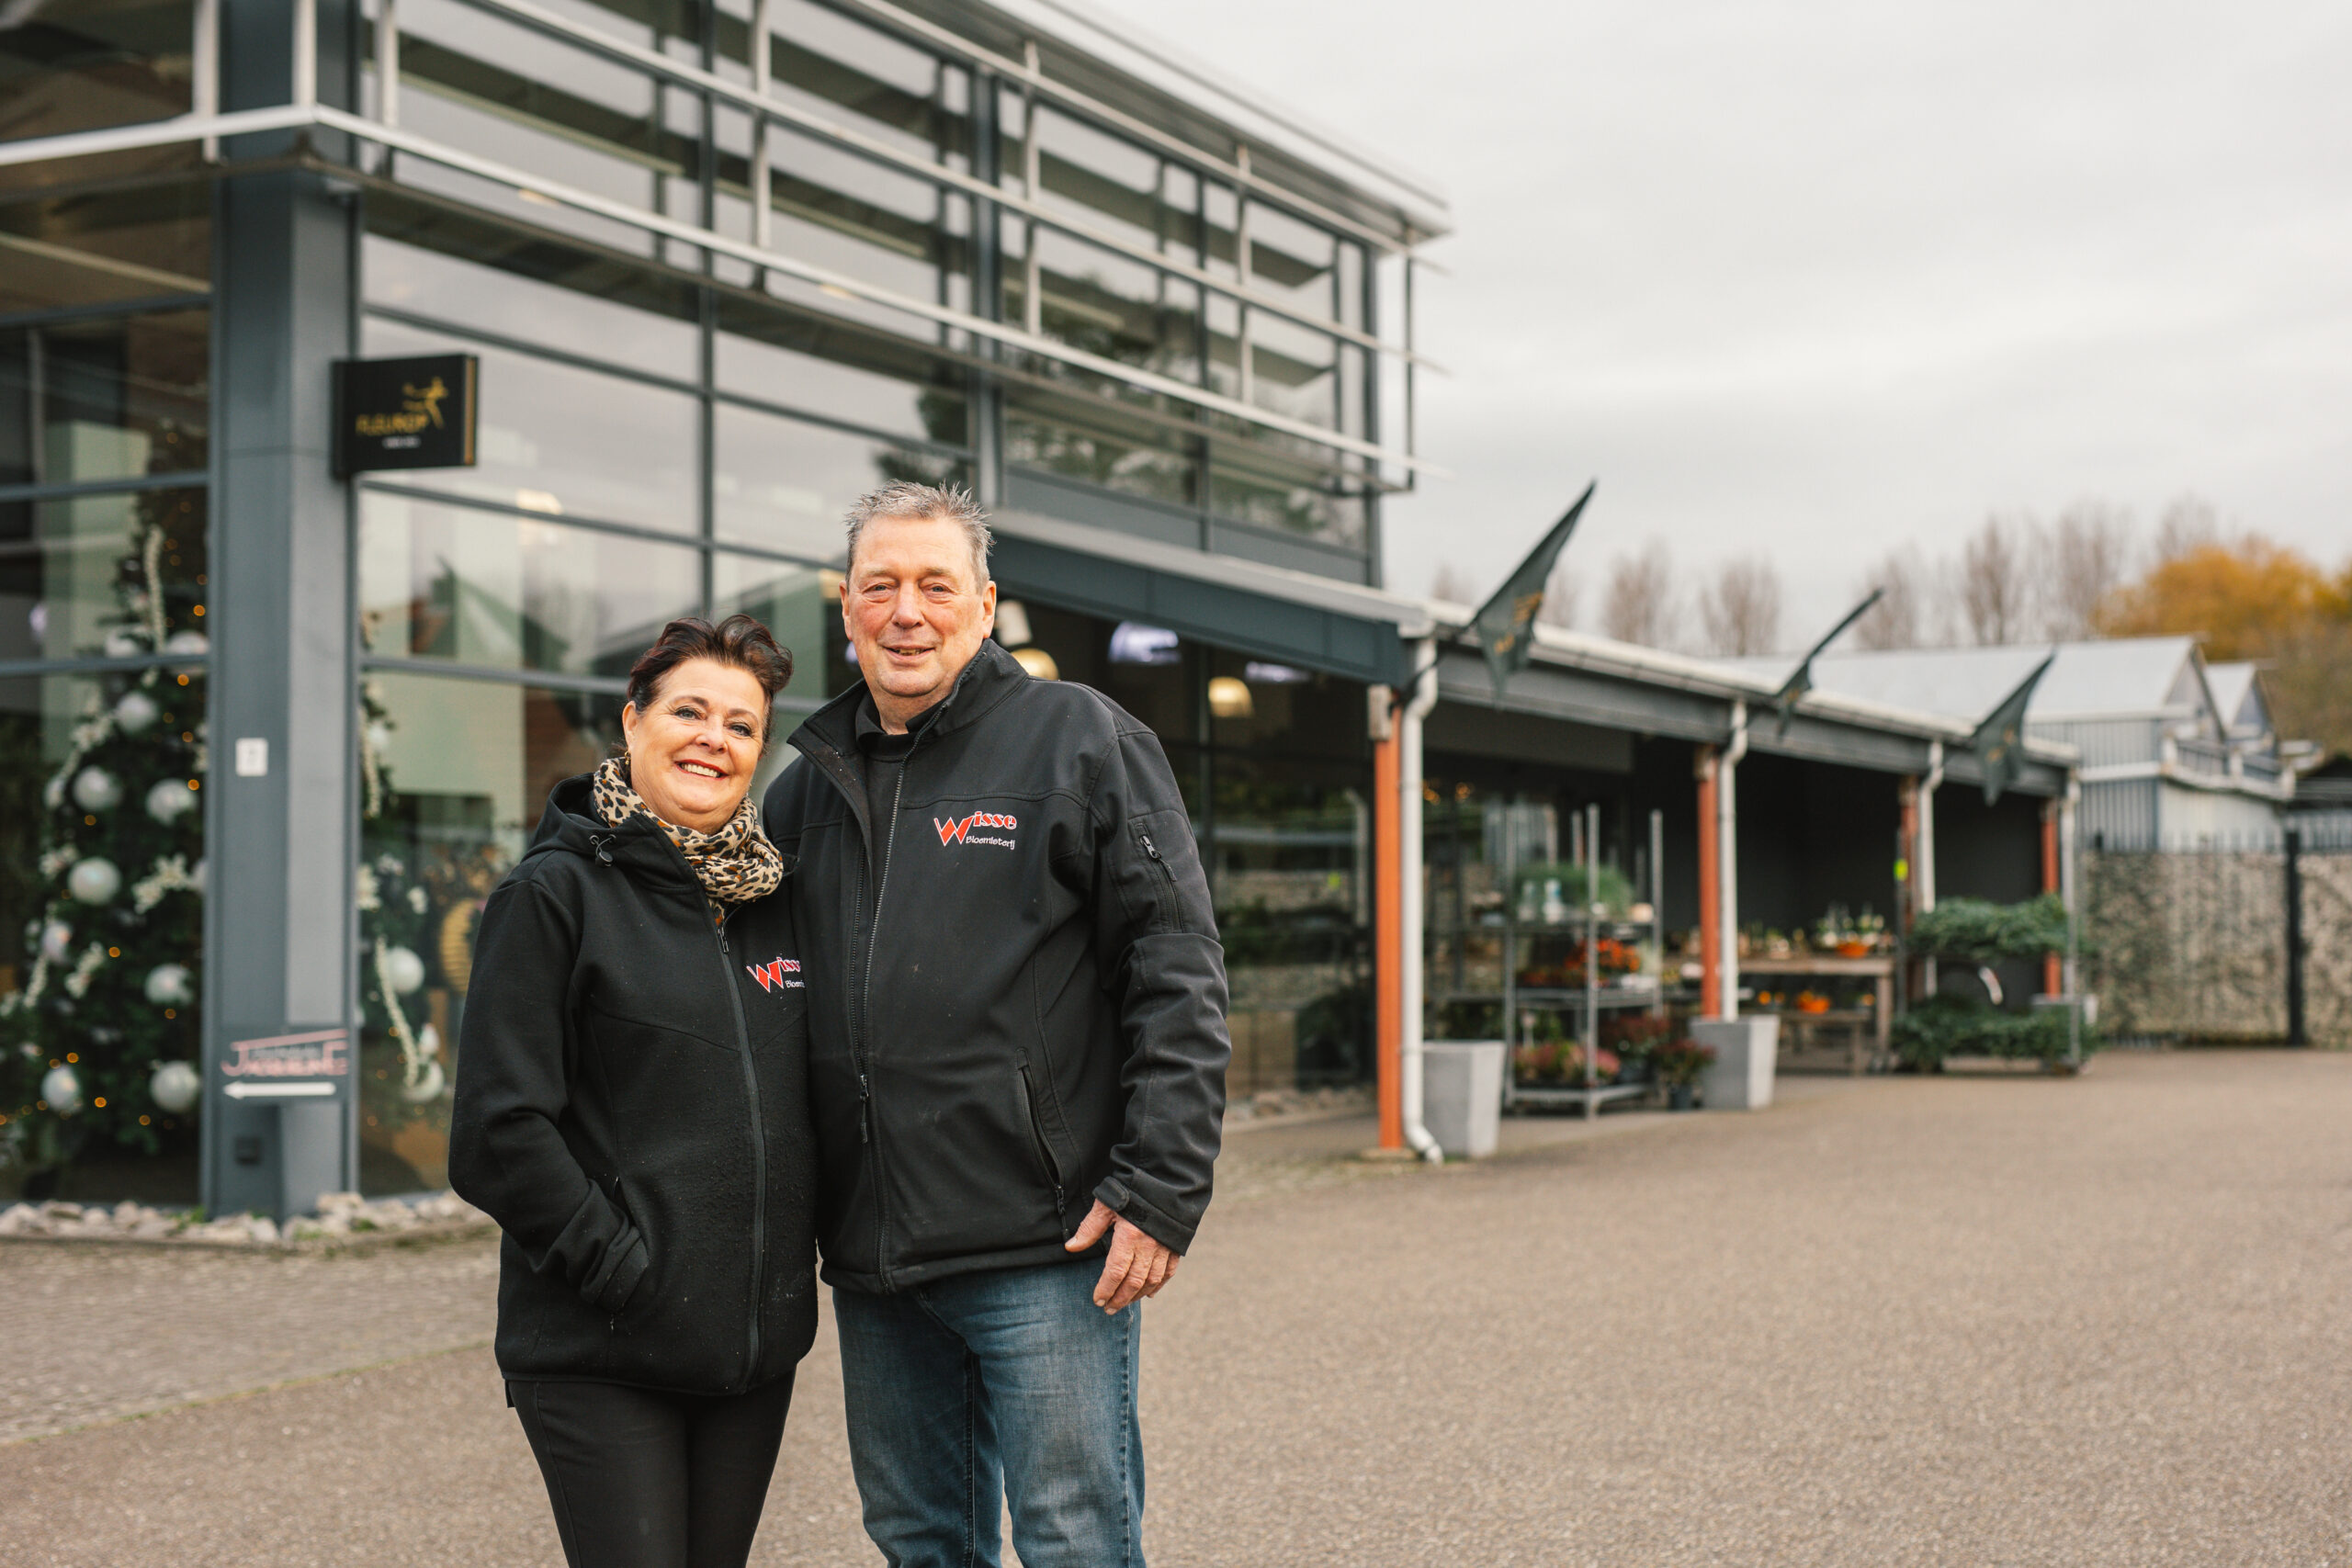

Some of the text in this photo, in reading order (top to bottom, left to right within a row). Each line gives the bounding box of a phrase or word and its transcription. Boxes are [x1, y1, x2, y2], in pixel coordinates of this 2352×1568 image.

[933, 811, 1017, 847] Wisse
[966, 835, 1016, 851] Bloemisterij
[746, 956, 801, 993] Wiss
